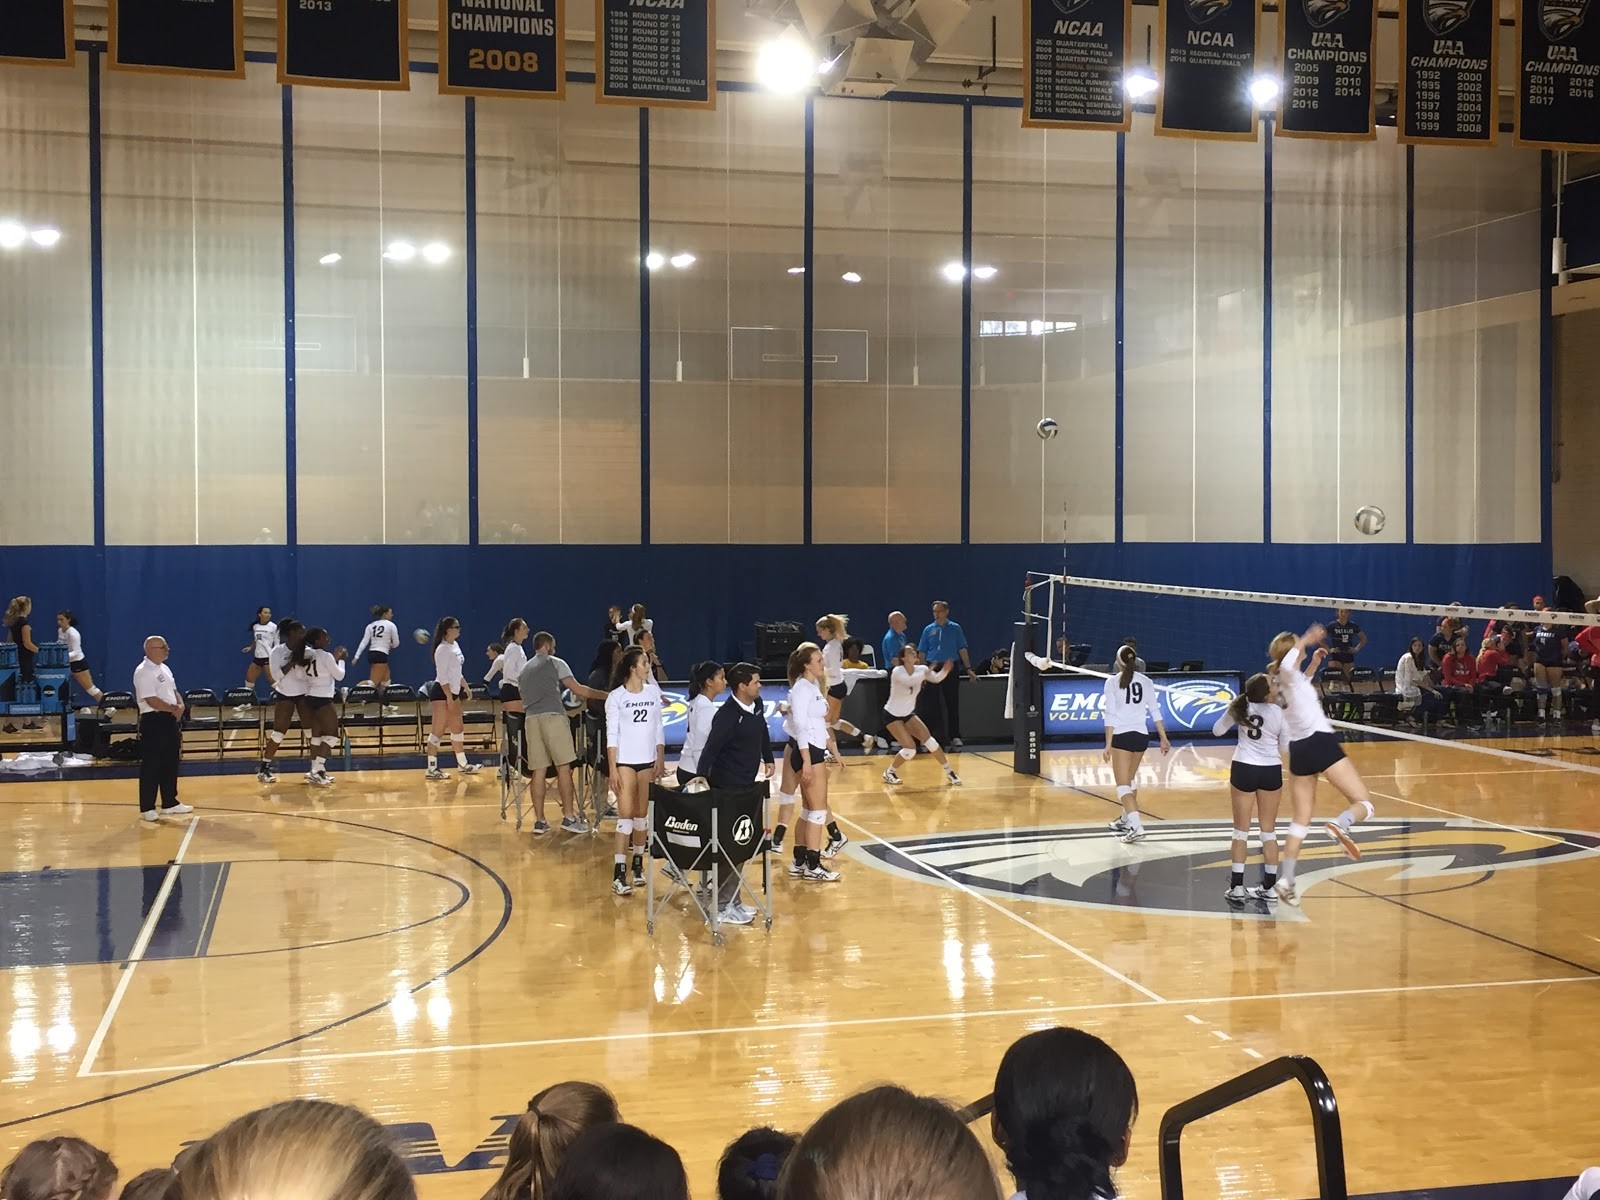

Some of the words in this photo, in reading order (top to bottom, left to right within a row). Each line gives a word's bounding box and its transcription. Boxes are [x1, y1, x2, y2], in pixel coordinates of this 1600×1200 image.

[299, 0, 332, 11] 2013
[461, 0, 544, 12] NATIONAL
[629, 0, 684, 8] NCAA
[451, 12, 554, 36] CHAMPIONS
[1054, 20, 1103, 36] NCAA
[1187, 30, 1234, 47] NCAA
[1311, 32, 1344, 48] UAA
[1056, 40, 1108, 49] QUARTERFINALS
[1433, 40, 1464, 55] UAA
[1288, 48, 1367, 63] CHAMPIONS
[1547, 45, 1578, 61] UAA
[468, 48, 538, 72] 2008
[1056, 55, 1108, 64] QUARTERFINALS
[1189, 57, 1241, 66] QUARTERFINALS
[1411, 56, 1487, 70] CHAMPIONS
[1294, 63, 1319, 72] 2005
[1336, 65, 1362, 74] 2007
[1525, 61, 1600, 75] CHAMPIONS
[1294, 76, 1319, 85] 2009
[1335, 78, 1361, 86] 2010
[1416, 71, 1440, 79] 1992
[1457, 72, 1482, 81] 2000
[1530, 75, 1554, 84] 2011
[1569, 78, 1594, 86] 2012
[632, 83, 690, 92] QUARTERFINALS
[1416, 81, 1440, 90] 1995
[1457, 83, 1482, 91] 2002
[1293, 88, 1318, 96] 2012
[1335, 88, 1362, 96] 2014
[1416, 91, 1440, 100] 1996
[1457, 93, 1482, 102] 2003
[1530, 86, 1554, 94] 2014
[1569, 89, 1594, 98] 2016
[1293, 100, 1319, 109] 2016
[1529, 96, 1554, 105] 2017
[1416, 102, 1440, 110] 1997
[1457, 103, 1482, 112] 2004
[1416, 112, 1440, 120] 1998
[1457, 113, 1482, 122] 2007
[1416, 122, 1440, 130] 1999
[1457, 124, 1482, 132] 2008
[372, 626, 384, 638] 12
[1342, 634, 1349, 643] 12
[304, 660, 318, 677] 21
[1126, 682, 1143, 704] 19
[633, 709, 648, 722] 22
[1247, 714, 1262, 740] 3
[664, 816, 698, 831] Baden
